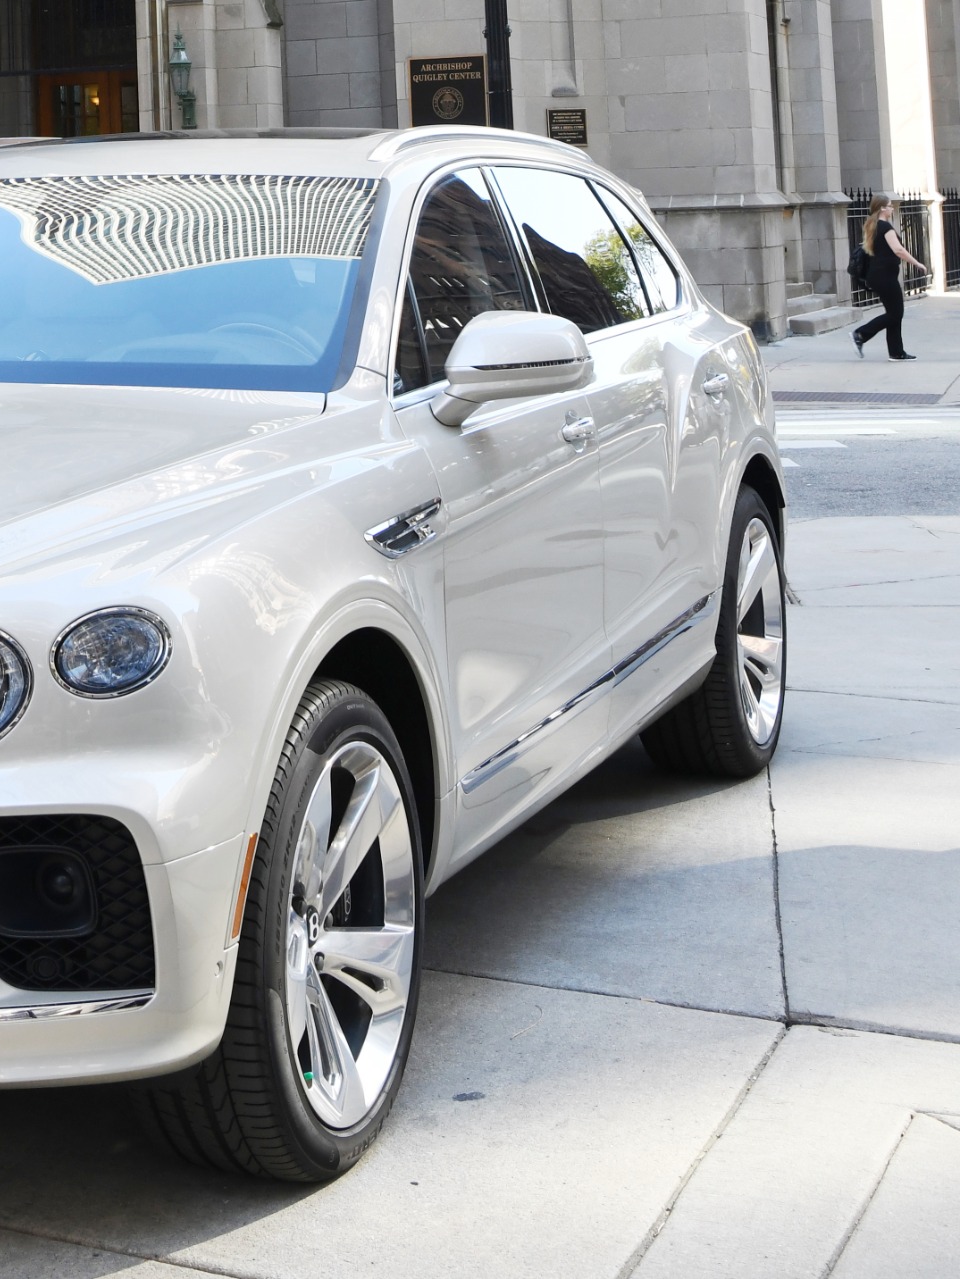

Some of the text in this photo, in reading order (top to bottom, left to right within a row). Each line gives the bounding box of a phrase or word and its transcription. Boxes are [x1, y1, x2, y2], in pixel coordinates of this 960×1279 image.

[420, 62, 473, 72] ARCHBISHOP
[412, 71, 481, 83] QUIGLEY CENTER
[309, 912, 319, 941] B
